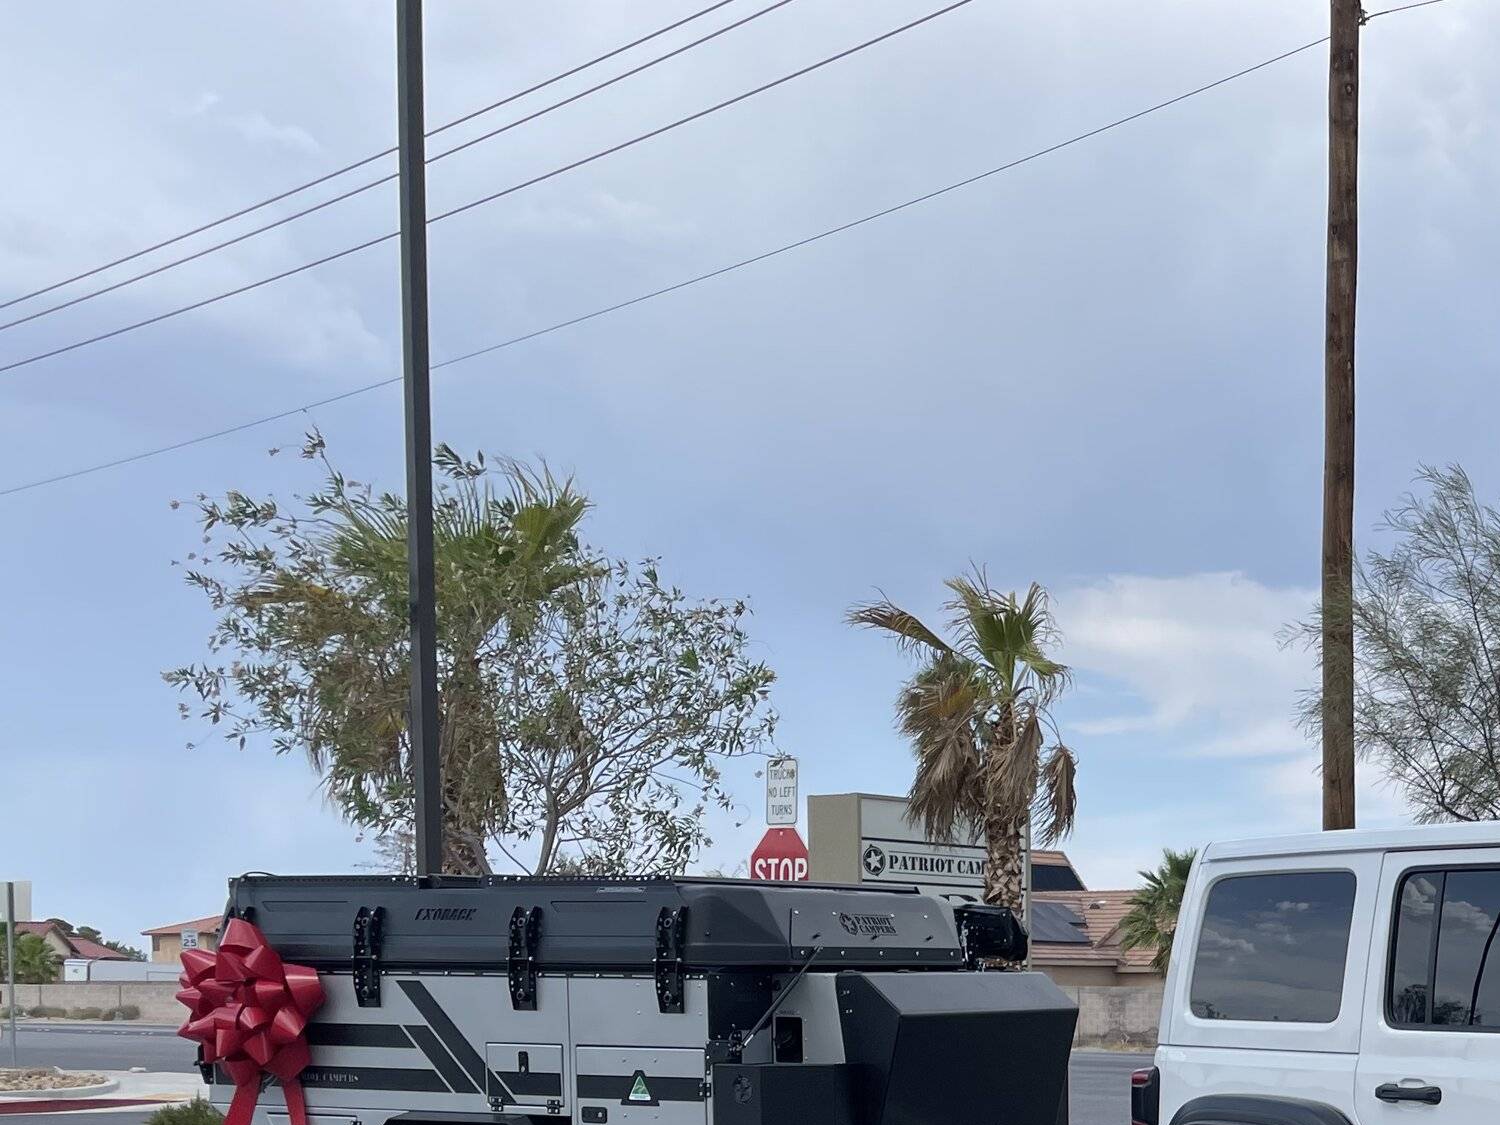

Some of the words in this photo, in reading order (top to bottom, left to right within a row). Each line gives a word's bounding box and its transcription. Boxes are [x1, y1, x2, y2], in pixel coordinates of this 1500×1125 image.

[768, 787, 778, 798] NO
[779, 786, 796, 798] LEFT
[771, 804, 793, 816] TURNS
[754, 857, 808, 881] STOP
[888, 854, 955, 873] PATRIOT
[956, 859, 987, 875] CAM
[854, 915, 893, 926] PATRIOT
[183, 938, 197, 947] 25
